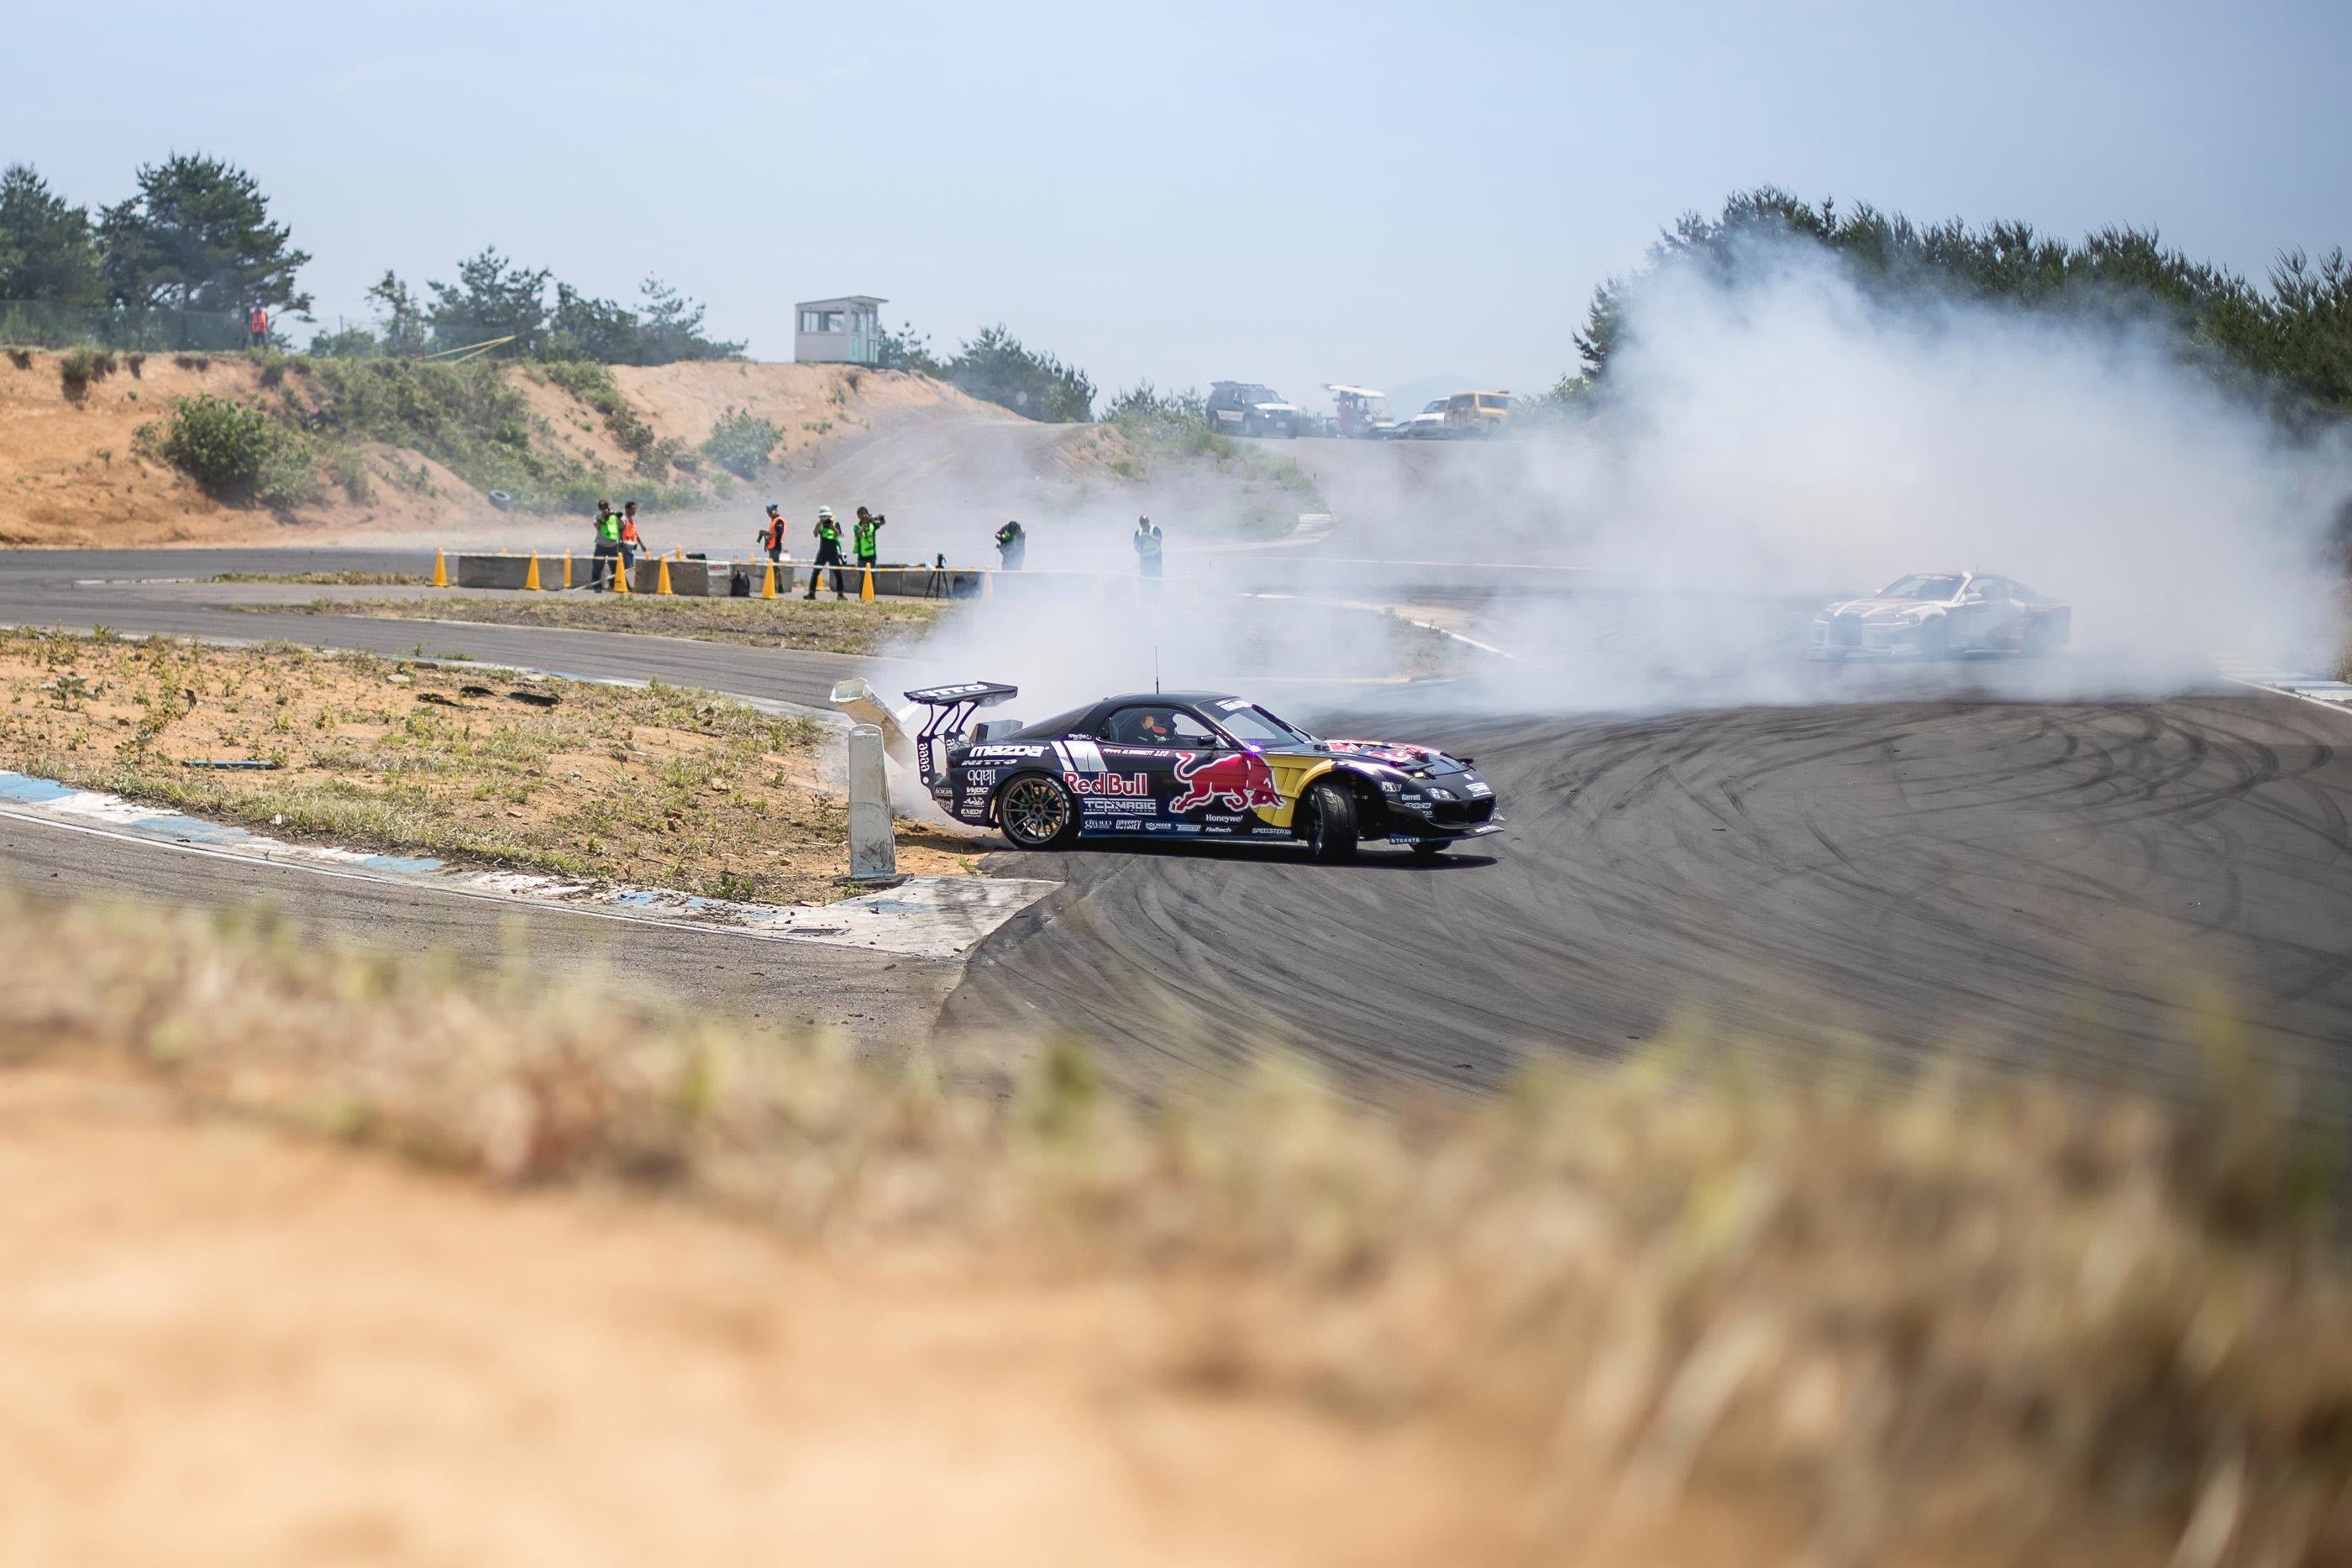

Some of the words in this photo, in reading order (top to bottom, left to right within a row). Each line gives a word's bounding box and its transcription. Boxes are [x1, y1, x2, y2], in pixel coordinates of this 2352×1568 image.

[967, 769, 996, 786] ilabb
[1063, 772, 1105, 794] Red
[1106, 773, 1148, 796] Bull
[1116, 801, 1157, 810] MAGIC
[1205, 814, 1243, 823] Honeywe
